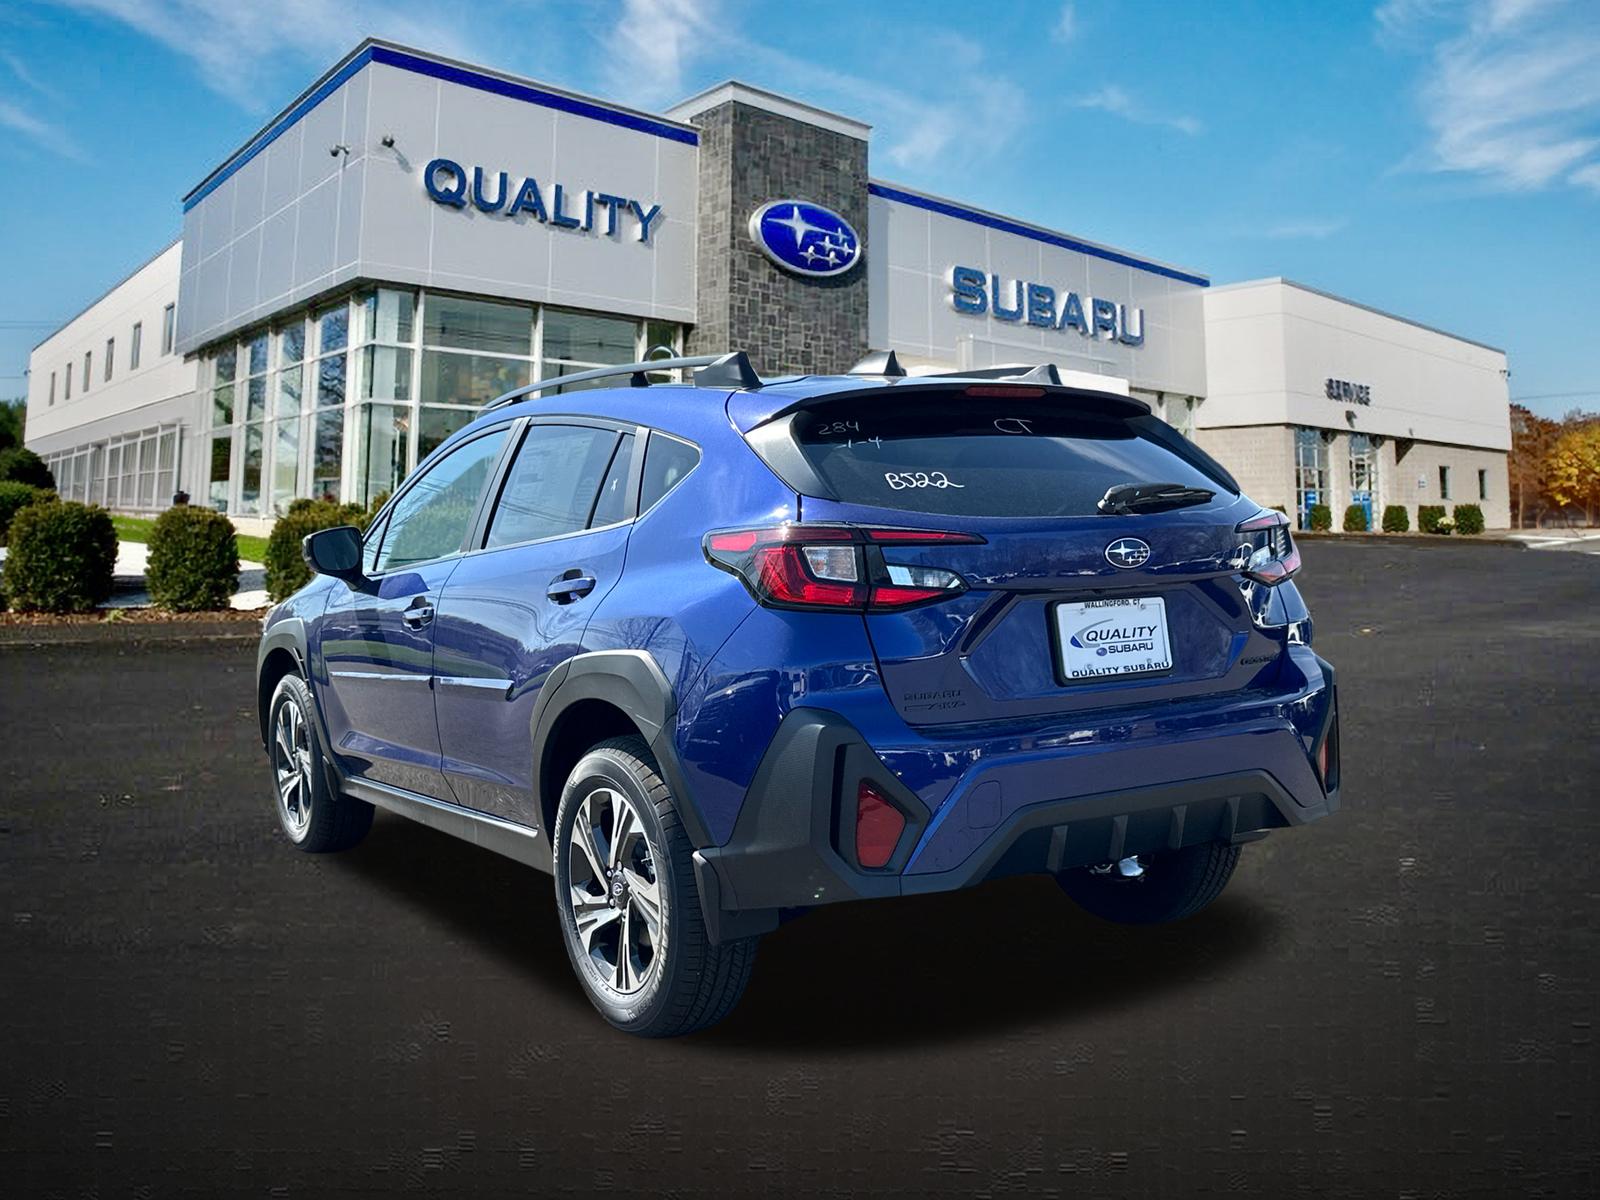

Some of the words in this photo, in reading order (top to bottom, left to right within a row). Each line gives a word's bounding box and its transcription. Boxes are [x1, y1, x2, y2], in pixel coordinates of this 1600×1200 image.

[424, 158, 661, 242] QUALITY
[951, 266, 1145, 347] SUBARU
[1132, 598, 1141, 607] CT
[1086, 625, 1158, 642] QUALITY
[1108, 642, 1154, 654] SUBARU
[1071, 666, 1120, 678] QUALITY
[1123, 660, 1170, 673] SUBARU
